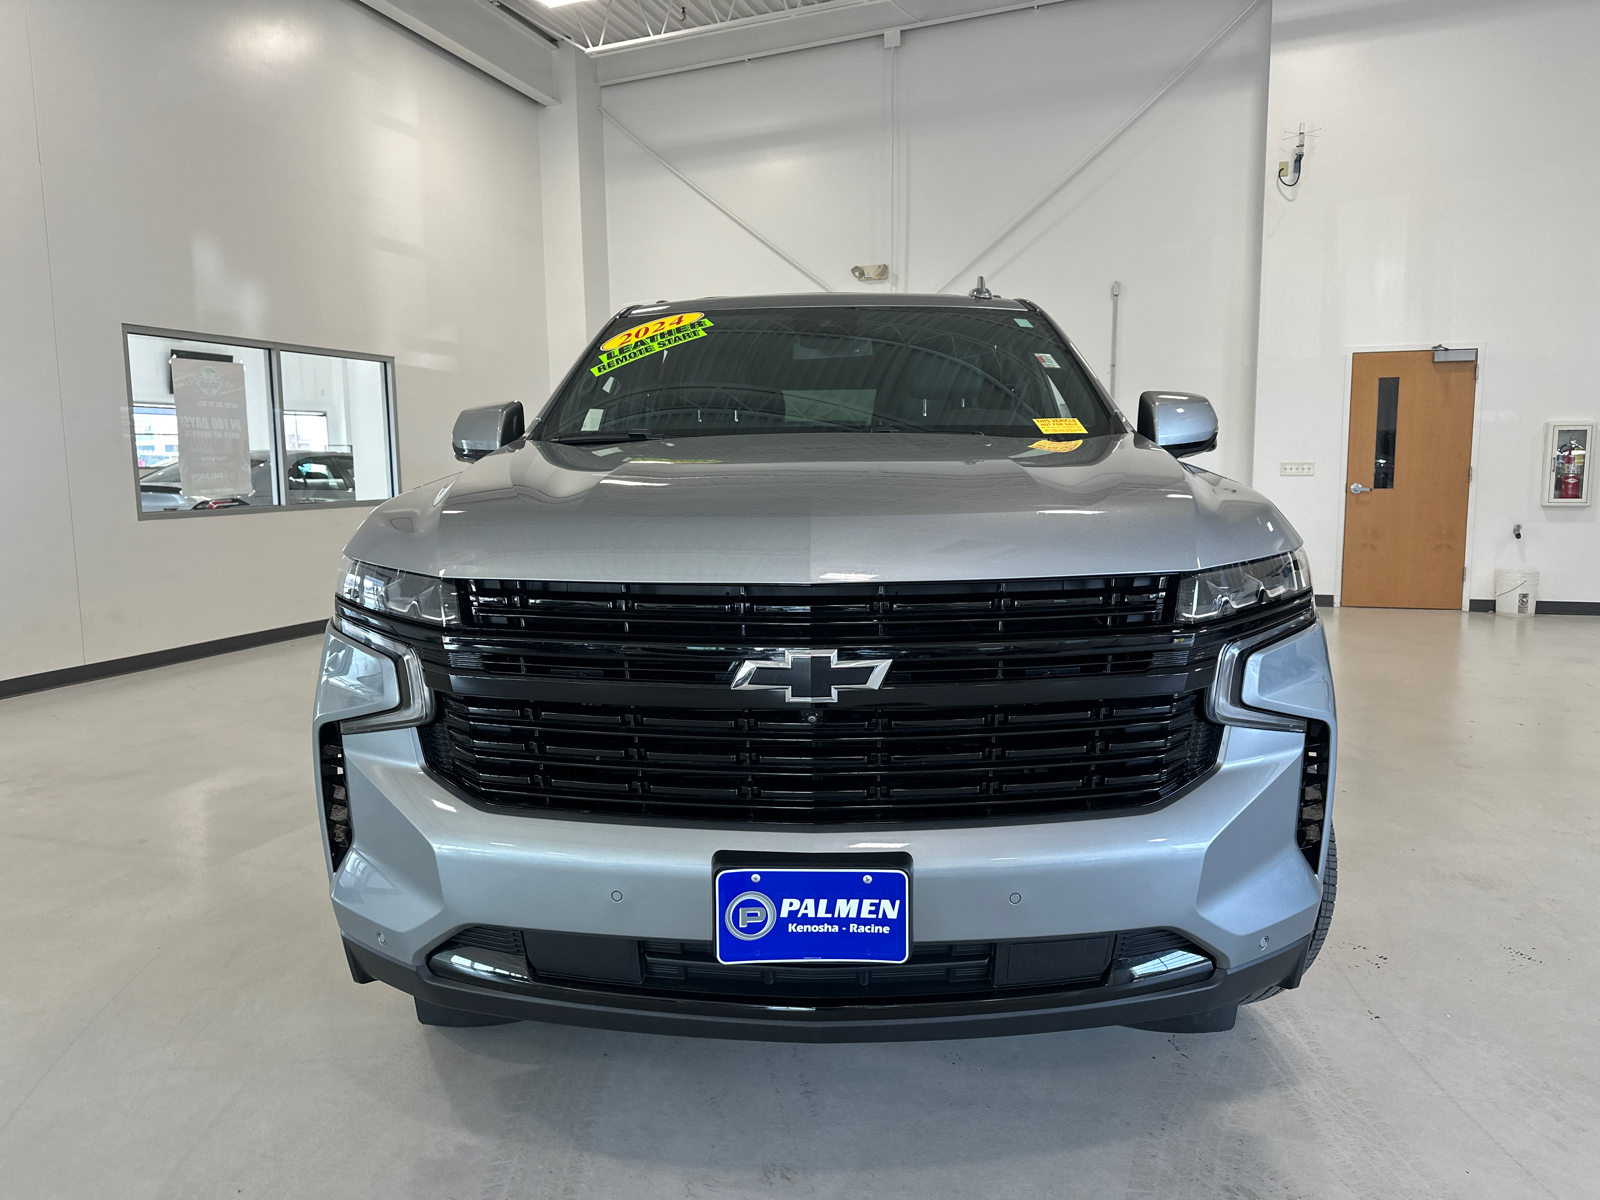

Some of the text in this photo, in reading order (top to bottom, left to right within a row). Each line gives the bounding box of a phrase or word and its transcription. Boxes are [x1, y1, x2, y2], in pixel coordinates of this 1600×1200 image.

[606, 319, 708, 361] LEATHER
[618, 315, 684, 348] 2024
[597, 329, 700, 374] REMOTE START
[739, 907, 766, 928] P
[780, 898, 900, 919] PALMEN
[788, 923, 839, 933] Kenosha
[849, 924, 890, 934] Racine
